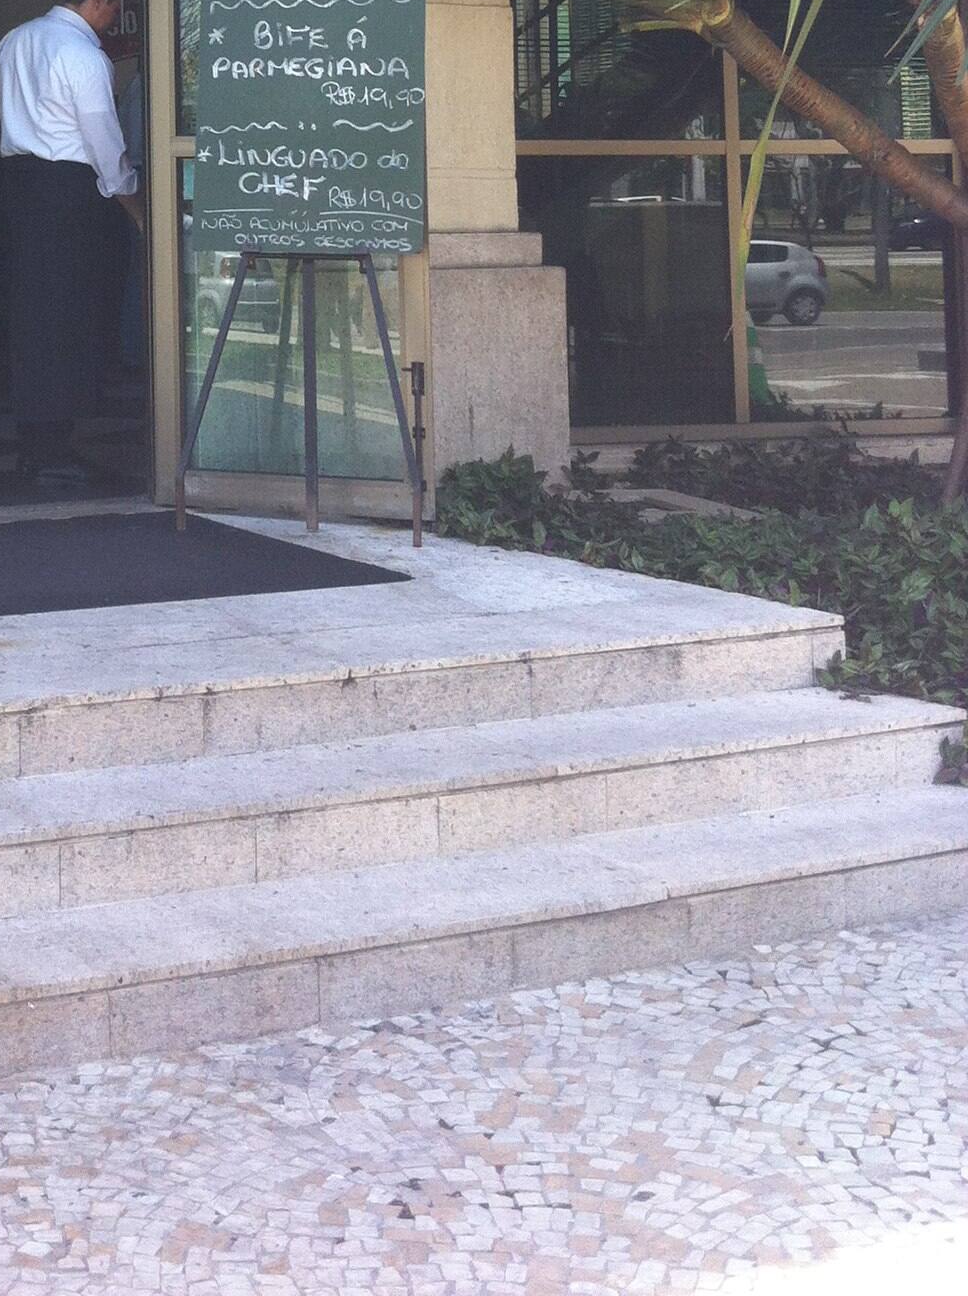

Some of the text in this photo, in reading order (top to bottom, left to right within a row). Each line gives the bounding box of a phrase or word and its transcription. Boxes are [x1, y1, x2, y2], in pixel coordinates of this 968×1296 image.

[211, 56, 411, 81] PARMEGIANA
[237, 171, 328, 201] CHEF
[201, 214, 243, 230] NÃO
[370, 218, 409, 233] COM
